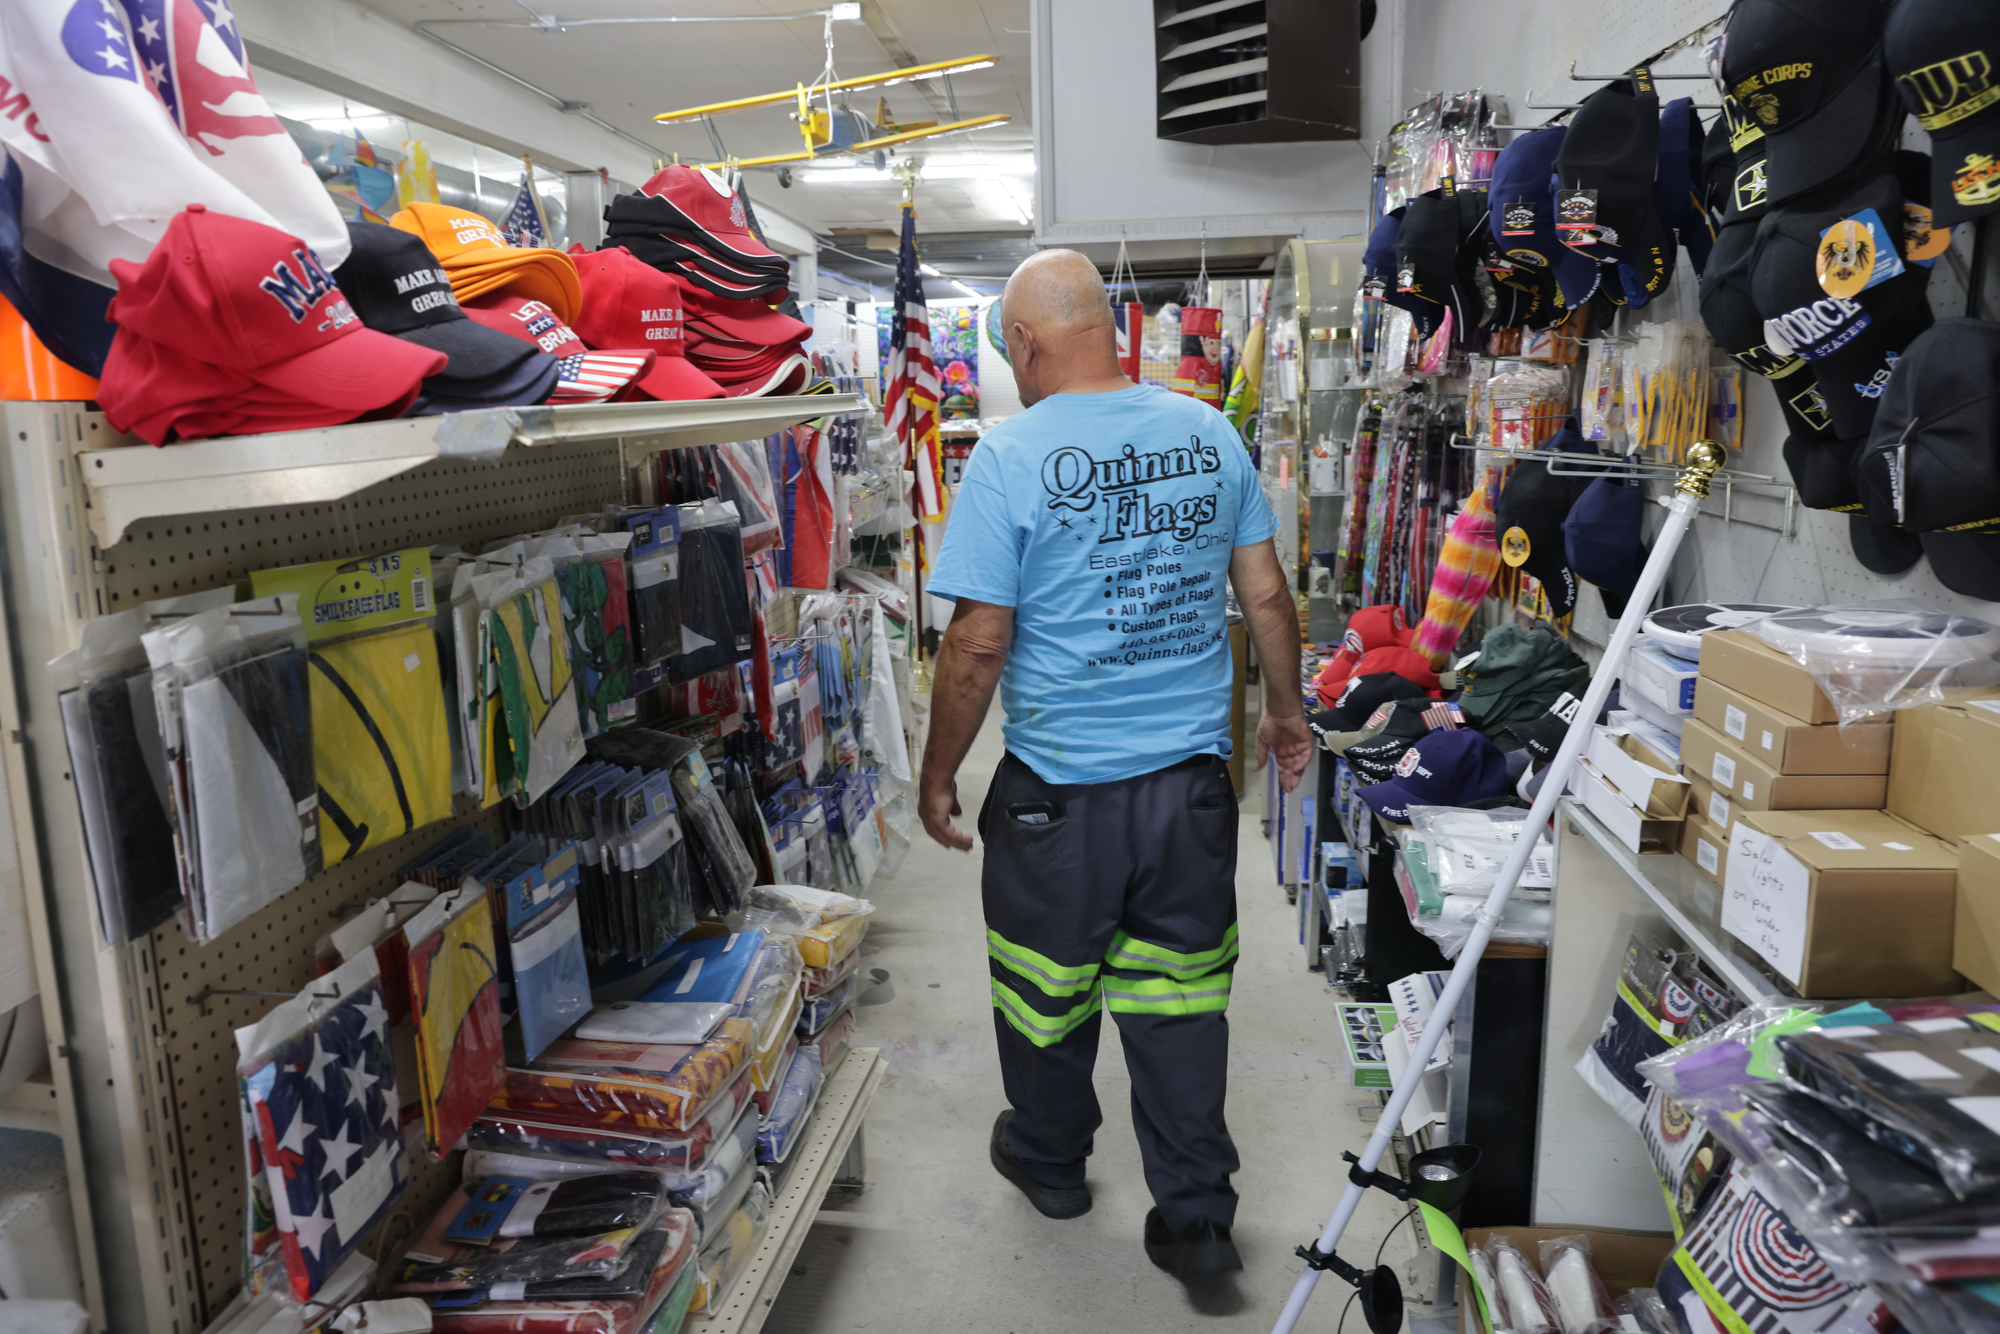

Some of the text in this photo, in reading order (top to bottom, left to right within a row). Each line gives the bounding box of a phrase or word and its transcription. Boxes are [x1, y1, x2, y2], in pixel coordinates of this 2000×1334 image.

[1762, 62, 1813, 85] CORPS
[394, 269, 435, 295] MAKE
[641, 308, 673, 322] MAKE
[1815, 319, 1867, 357] STATES
[1042, 435, 1221, 511] Quinn's
[1098, 488, 1217, 544] Flags
[1089, 532, 1230, 570] Eastlake, Ohio
[381, 556, 390, 573] X
[1117, 562, 1182, 582] Flag Poles
[1117, 570, 1211, 599] Flag Pole Repair
[375, 590, 401, 613] FLAG
[1121, 587, 1214, 616] All Types of Flags
[1121, 609, 1198, 634] Custom Flags
[1528, 739, 1550, 754] SWAT
[1381, 806, 1402, 818] FIRE
[1741, 839, 1772, 865] Solar
[1752, 864, 1785, 891] lights
[1733, 890, 1771, 912] on pole
